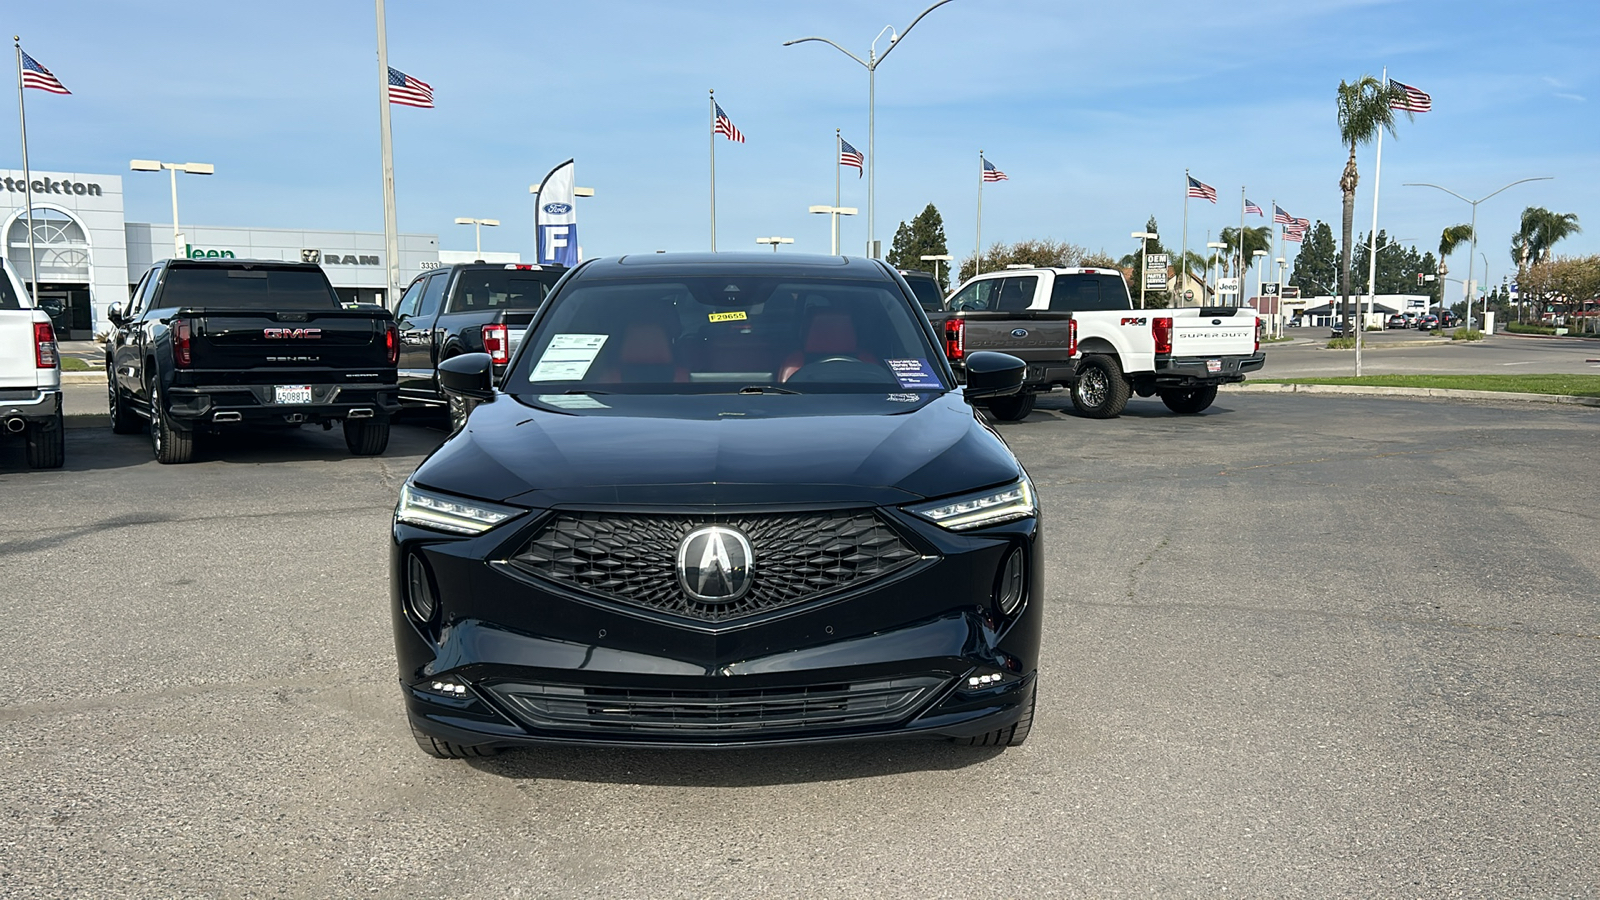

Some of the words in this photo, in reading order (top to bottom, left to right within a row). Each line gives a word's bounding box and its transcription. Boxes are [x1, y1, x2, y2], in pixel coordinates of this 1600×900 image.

[547, 204, 567, 213] Ford
[545, 226, 569, 260] F
[324, 254, 380, 266] RAM
[1147, 255, 1167, 263] OEM
[420, 262, 439, 270] 3333
[1219, 283, 1238, 292] Jeep
[1120, 317, 1147, 326] FX4
[264, 328, 321, 339] GMC
[277, 391, 311, 402] 45088T3
